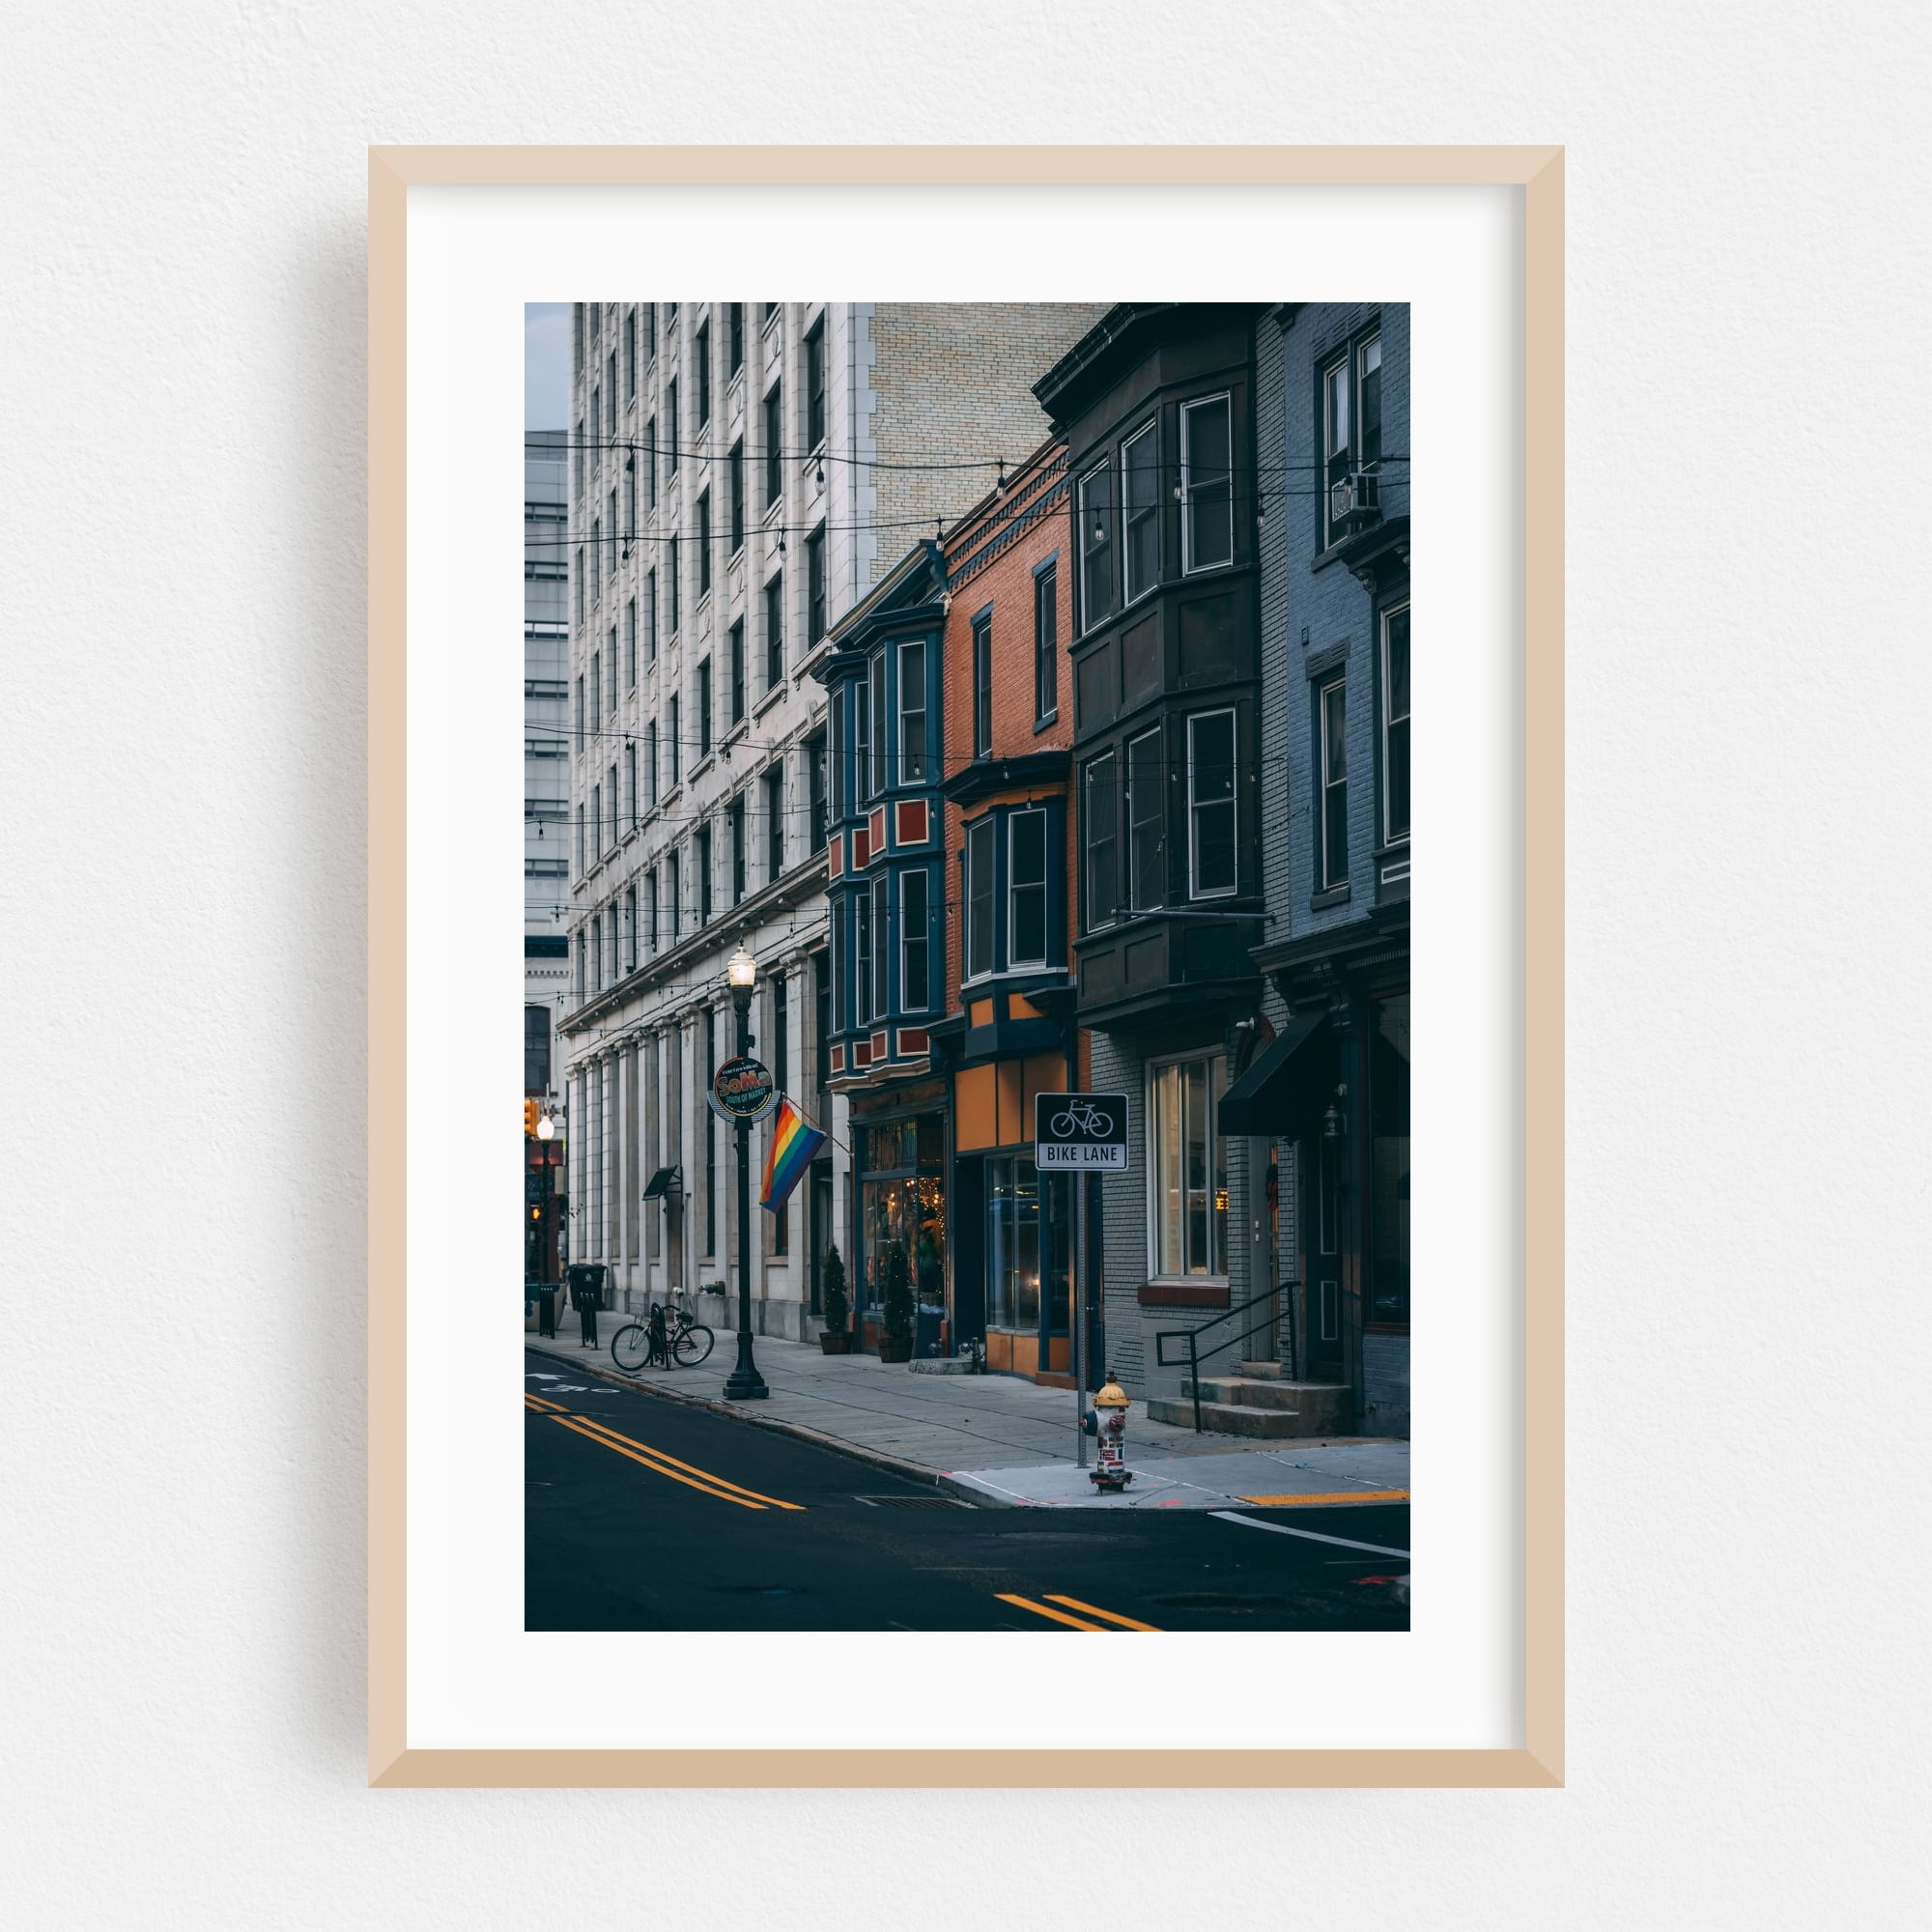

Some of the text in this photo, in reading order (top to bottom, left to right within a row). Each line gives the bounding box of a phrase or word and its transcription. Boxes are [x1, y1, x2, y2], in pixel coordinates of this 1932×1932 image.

[726, 1095, 741, 1104] SOUTH
[741, 1094, 748, 1102] OF
[748, 1088, 766, 1099] MARKET
[1047, 1147, 1118, 1161] BIKE LANE
